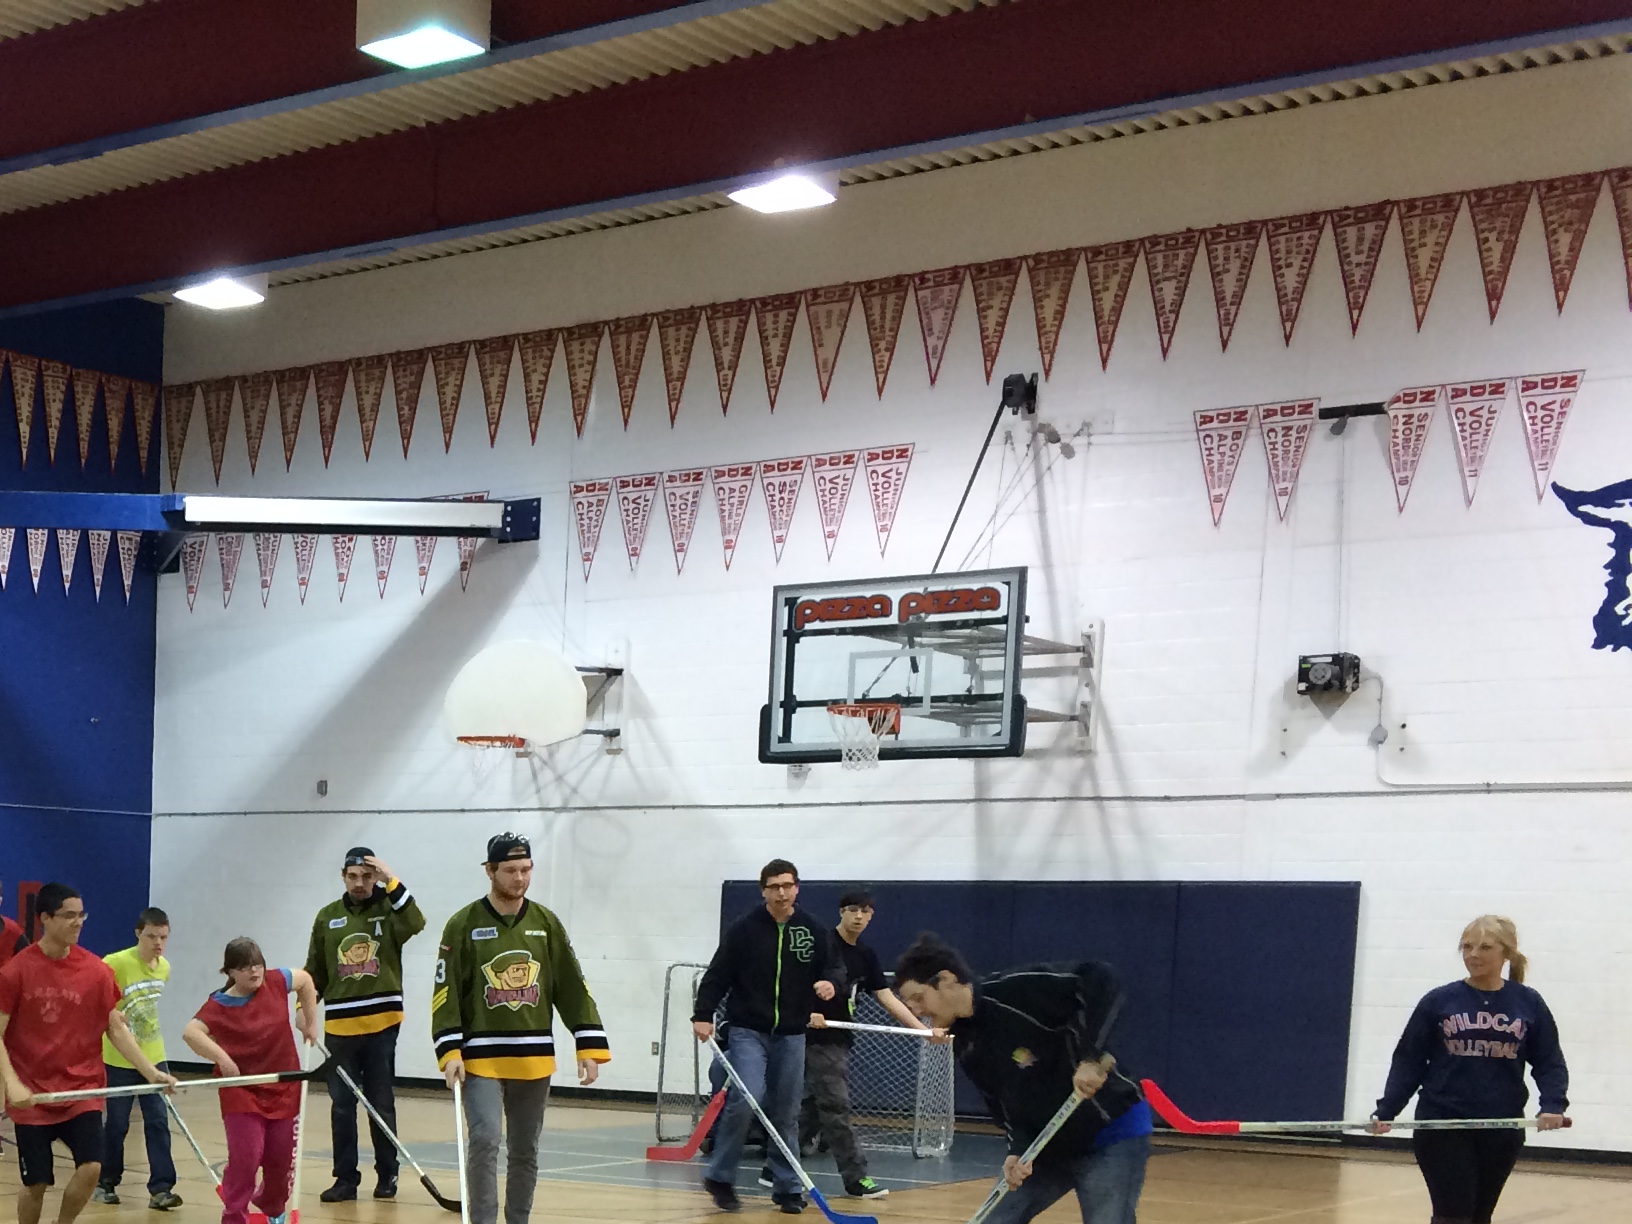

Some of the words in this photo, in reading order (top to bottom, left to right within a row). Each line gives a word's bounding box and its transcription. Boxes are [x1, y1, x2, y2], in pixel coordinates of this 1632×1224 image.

[1450, 381, 1506, 400] NDA
[1521, 374, 1578, 393] NDA
[1199, 409, 1249, 427] NDA
[1262, 402, 1314, 420] NDA
[814, 453, 856, 470] NDA
[866, 447, 910, 464] NDA
[762, 459, 804, 475] NDA
[374, 920, 383, 936] A
[1439, 1011, 1527, 1040] WILDCA
